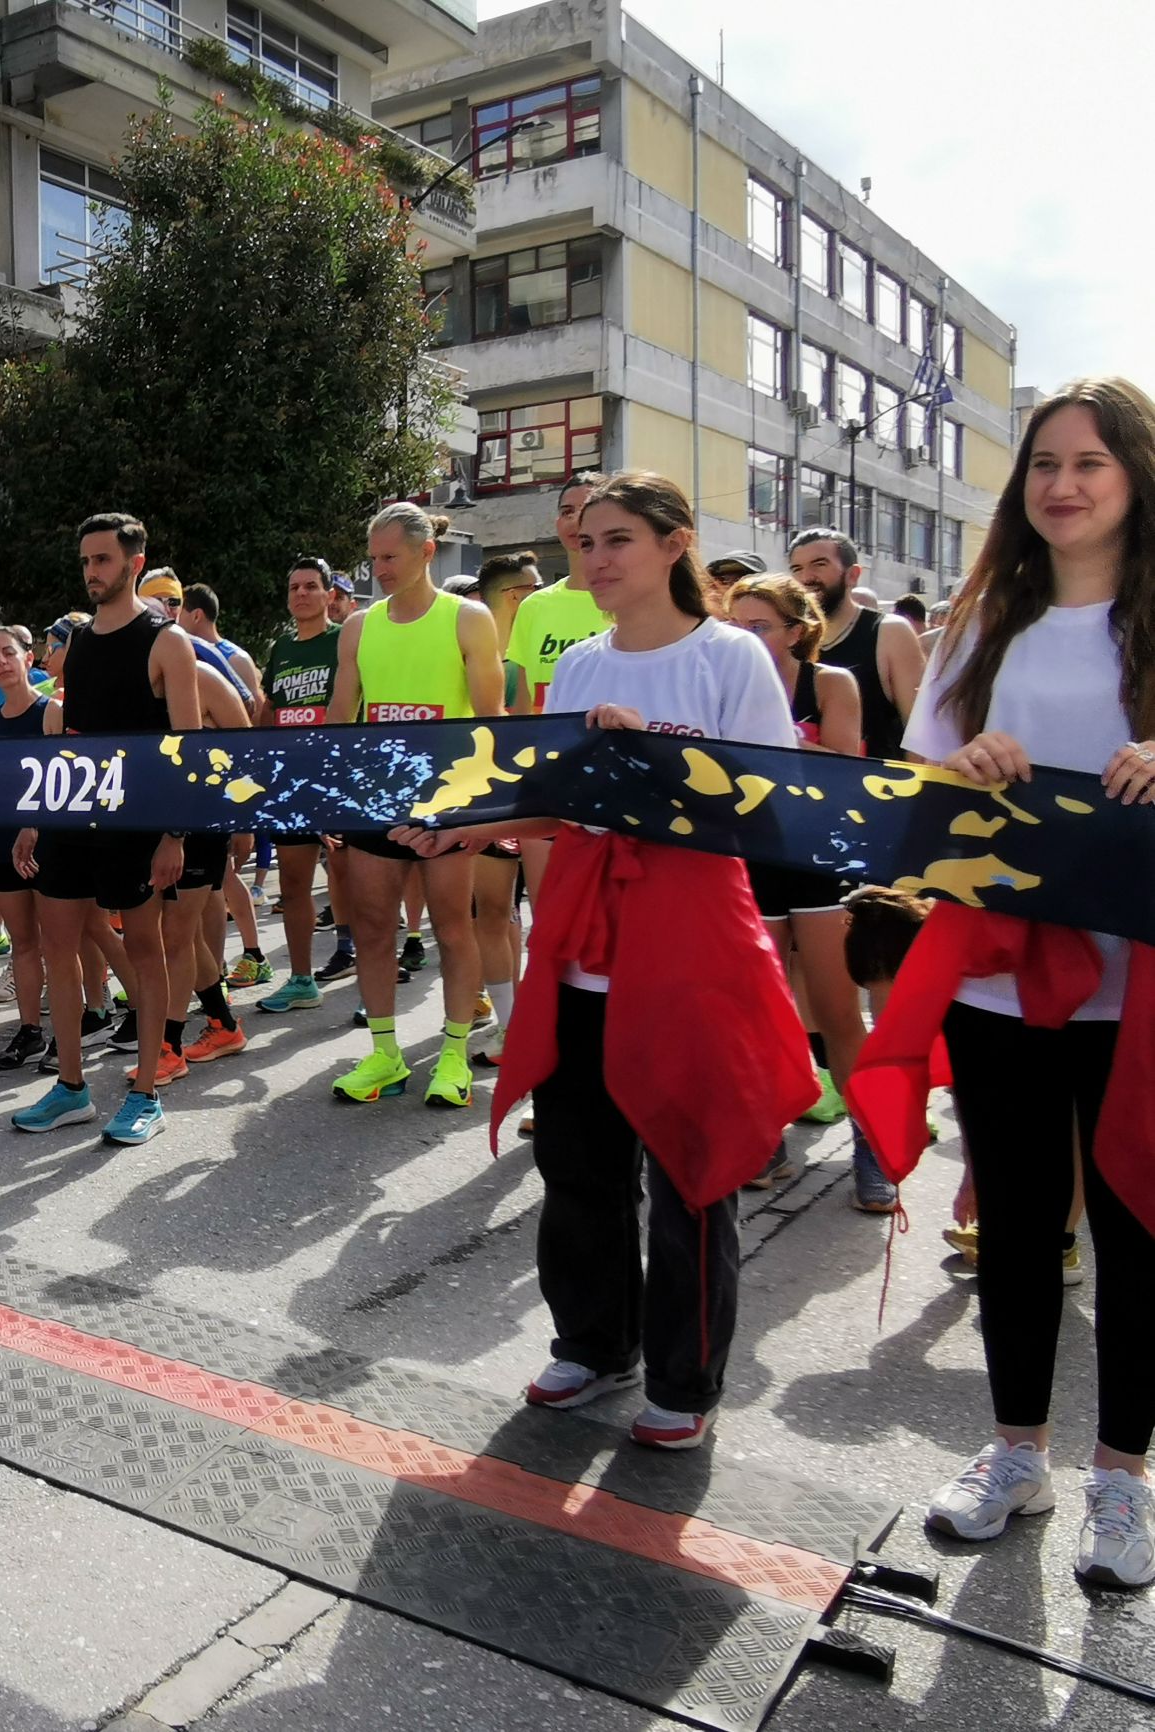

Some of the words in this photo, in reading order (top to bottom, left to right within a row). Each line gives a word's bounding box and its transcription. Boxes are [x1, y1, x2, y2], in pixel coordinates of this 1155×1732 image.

[285, 681, 328, 702] ΥΓΕΙΑΣ
[279, 708, 316, 725] ERGO
[378, 705, 431, 722] ERGO
[16, 755, 126, 812] 2024
